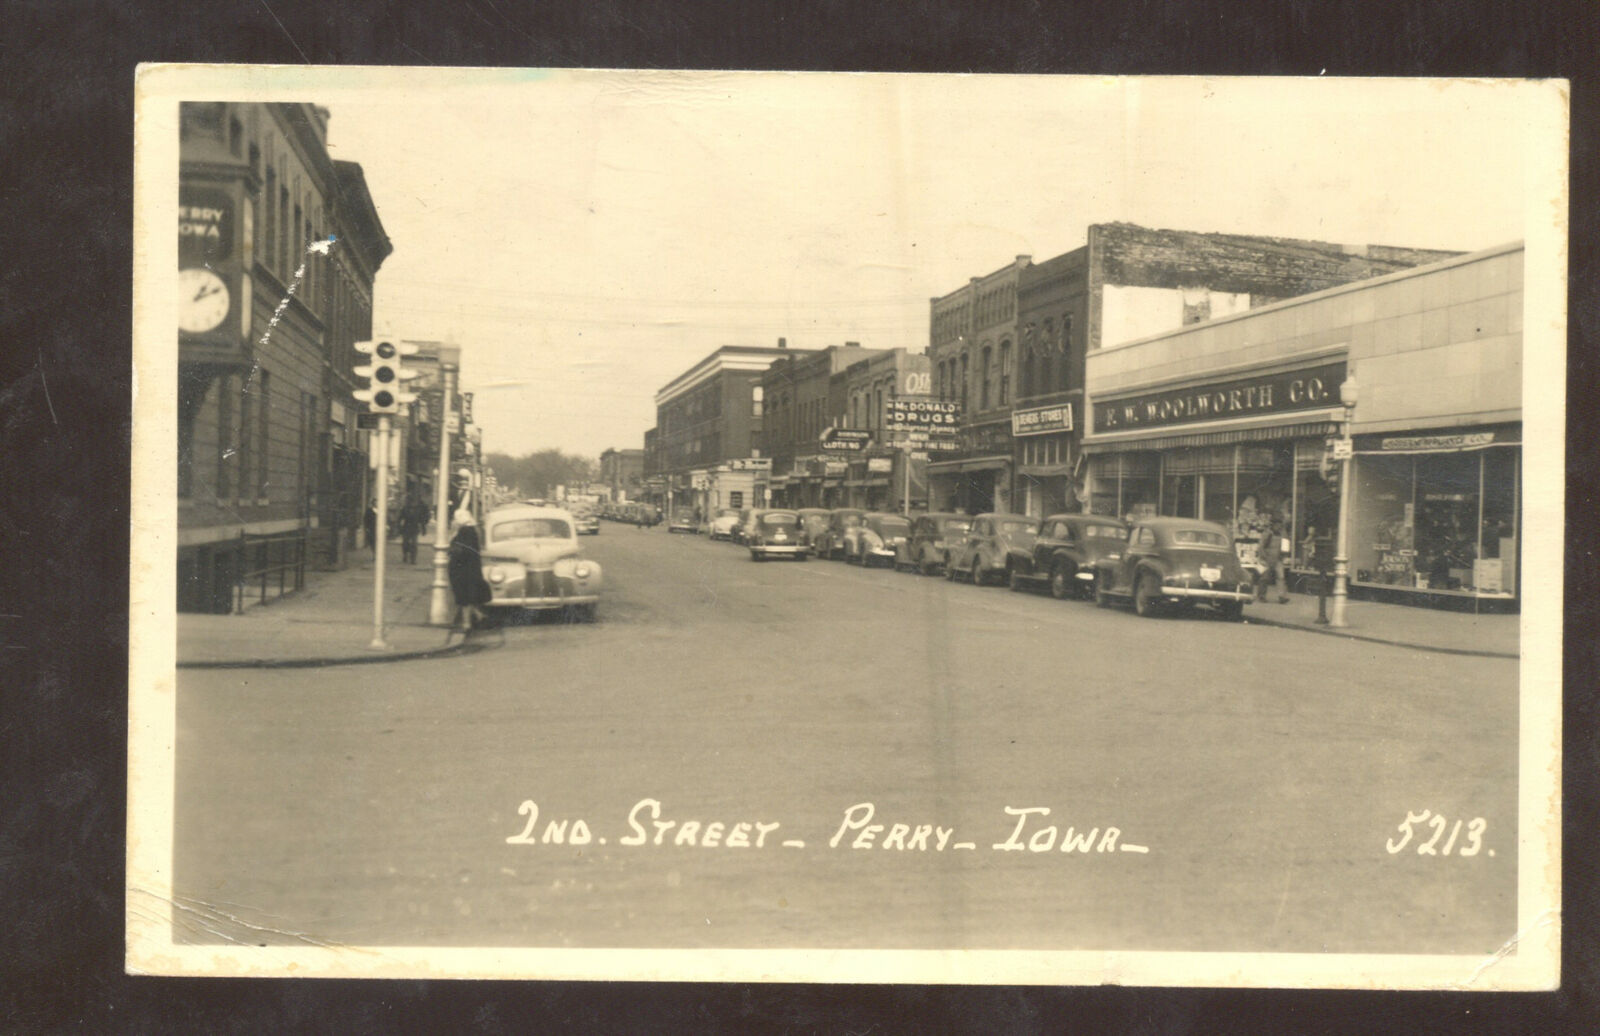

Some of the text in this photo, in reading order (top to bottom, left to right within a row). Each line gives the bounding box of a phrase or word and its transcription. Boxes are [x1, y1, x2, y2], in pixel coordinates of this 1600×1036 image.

[1147, 384, 1273, 421] WOOLWORTH
[1289, 377, 1329, 403] CO.
[894, 412, 955, 423] DRUGS
